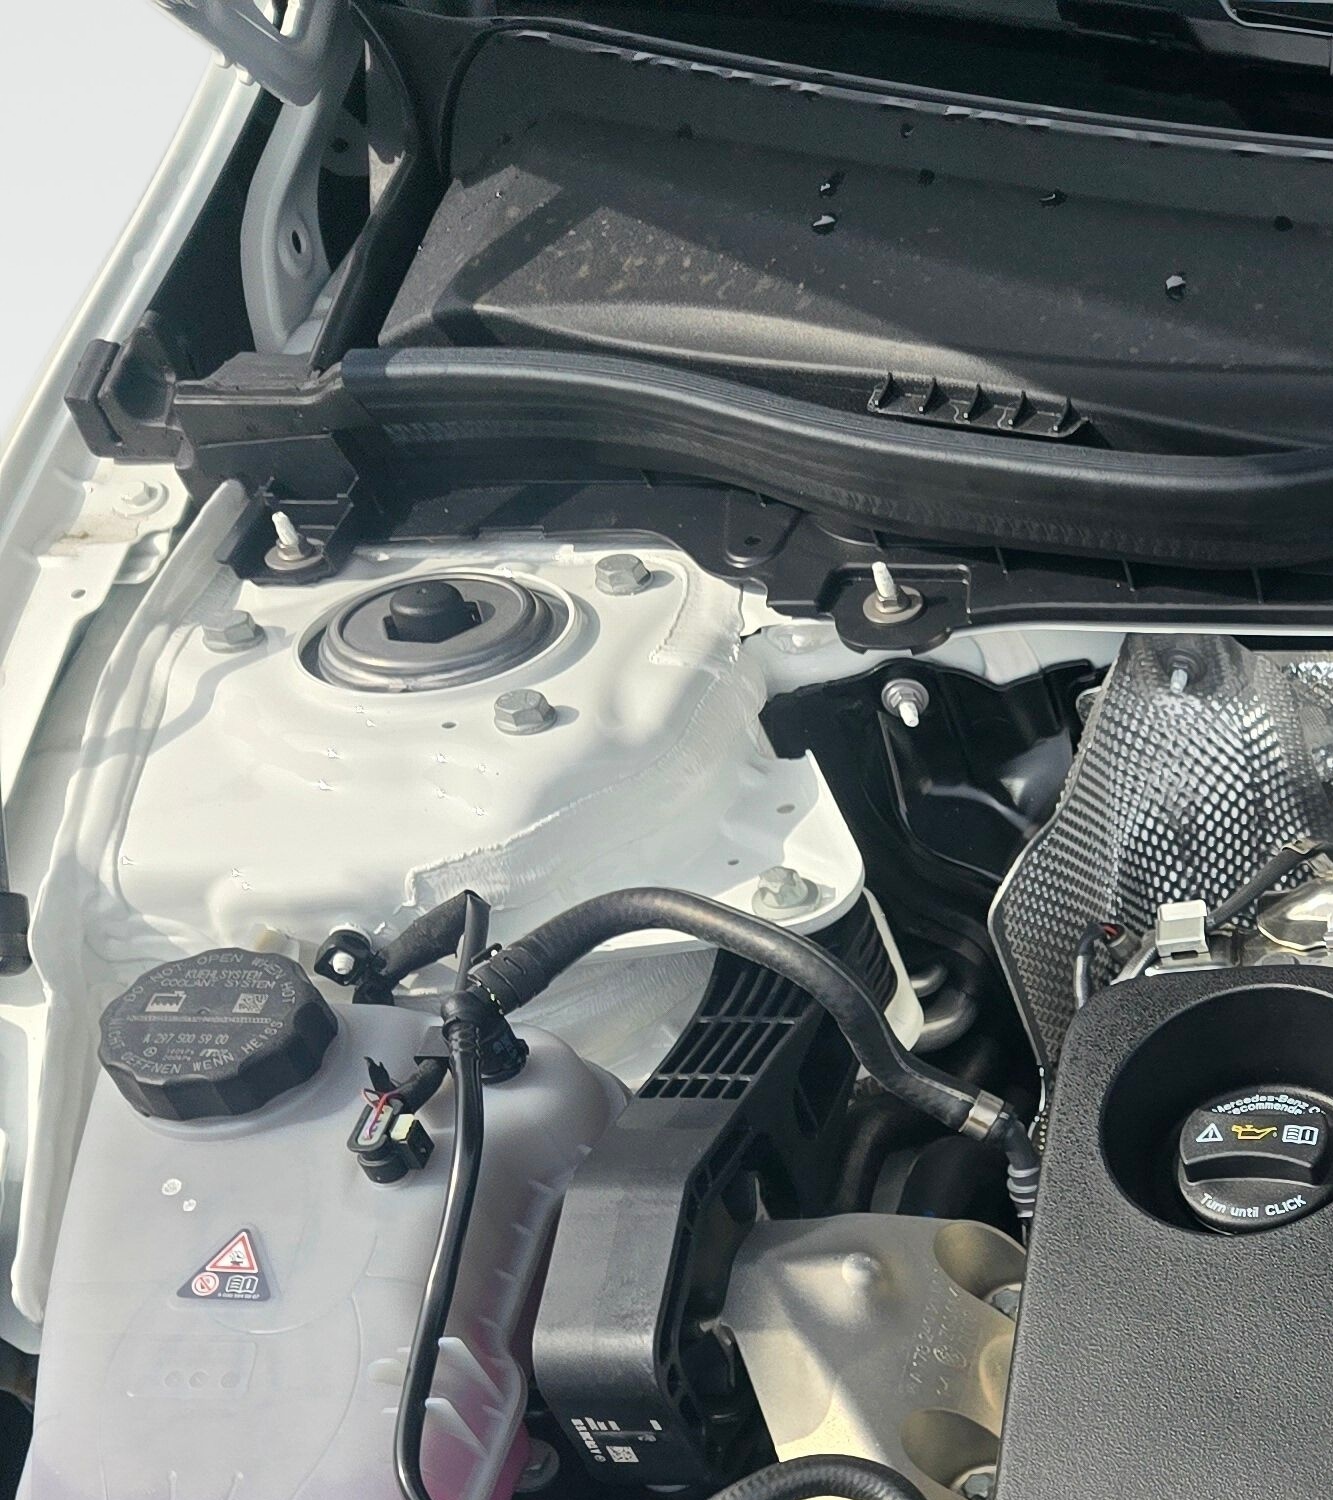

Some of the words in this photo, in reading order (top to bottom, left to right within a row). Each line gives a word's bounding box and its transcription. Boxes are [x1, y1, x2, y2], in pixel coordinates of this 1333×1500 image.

[123, 984, 144, 1003] DO
[150, 962, 185, 984] NOT
[196, 953, 245, 967] OPEN
[251, 957, 287, 980] WHEN
[280, 981, 296, 1005] HOT
[224, 979, 277, 990] SYSTEM
[120, 1051, 182, 1075] OEFFNEN
[192, 1052, 236, 1073] WENN
[240, 1020, 285, 1056] HEISS
[1199, 1191, 1227, 1214] Turn
[1229, 1205, 1260, 1218] until
[1265, 1194, 1308, 1217] CLICK
